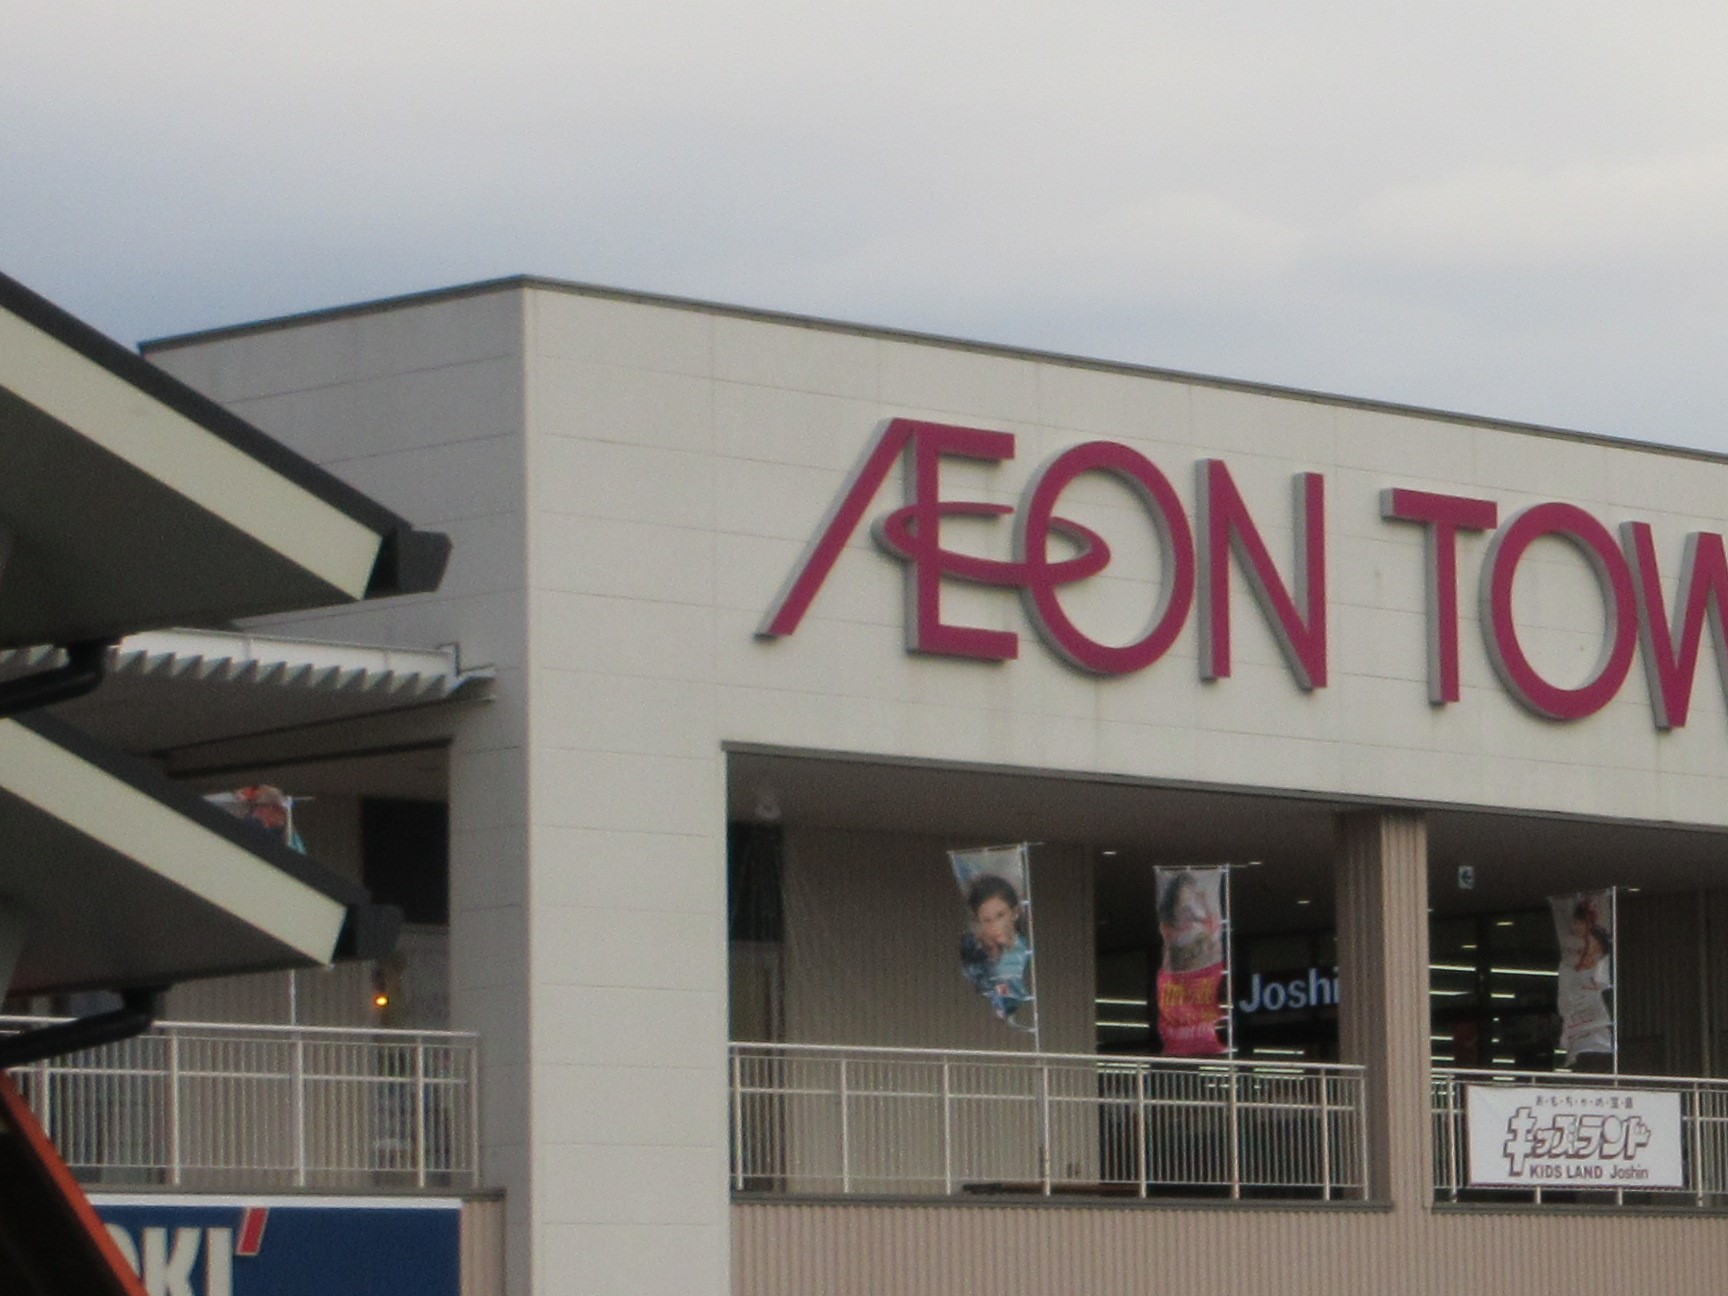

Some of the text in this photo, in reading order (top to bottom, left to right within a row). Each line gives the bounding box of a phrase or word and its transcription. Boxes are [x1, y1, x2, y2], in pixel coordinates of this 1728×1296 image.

[1503, 1106, 1652, 1177] キッズランド
[1529, 1163, 1649, 1179] KIDS LAND Joshin
